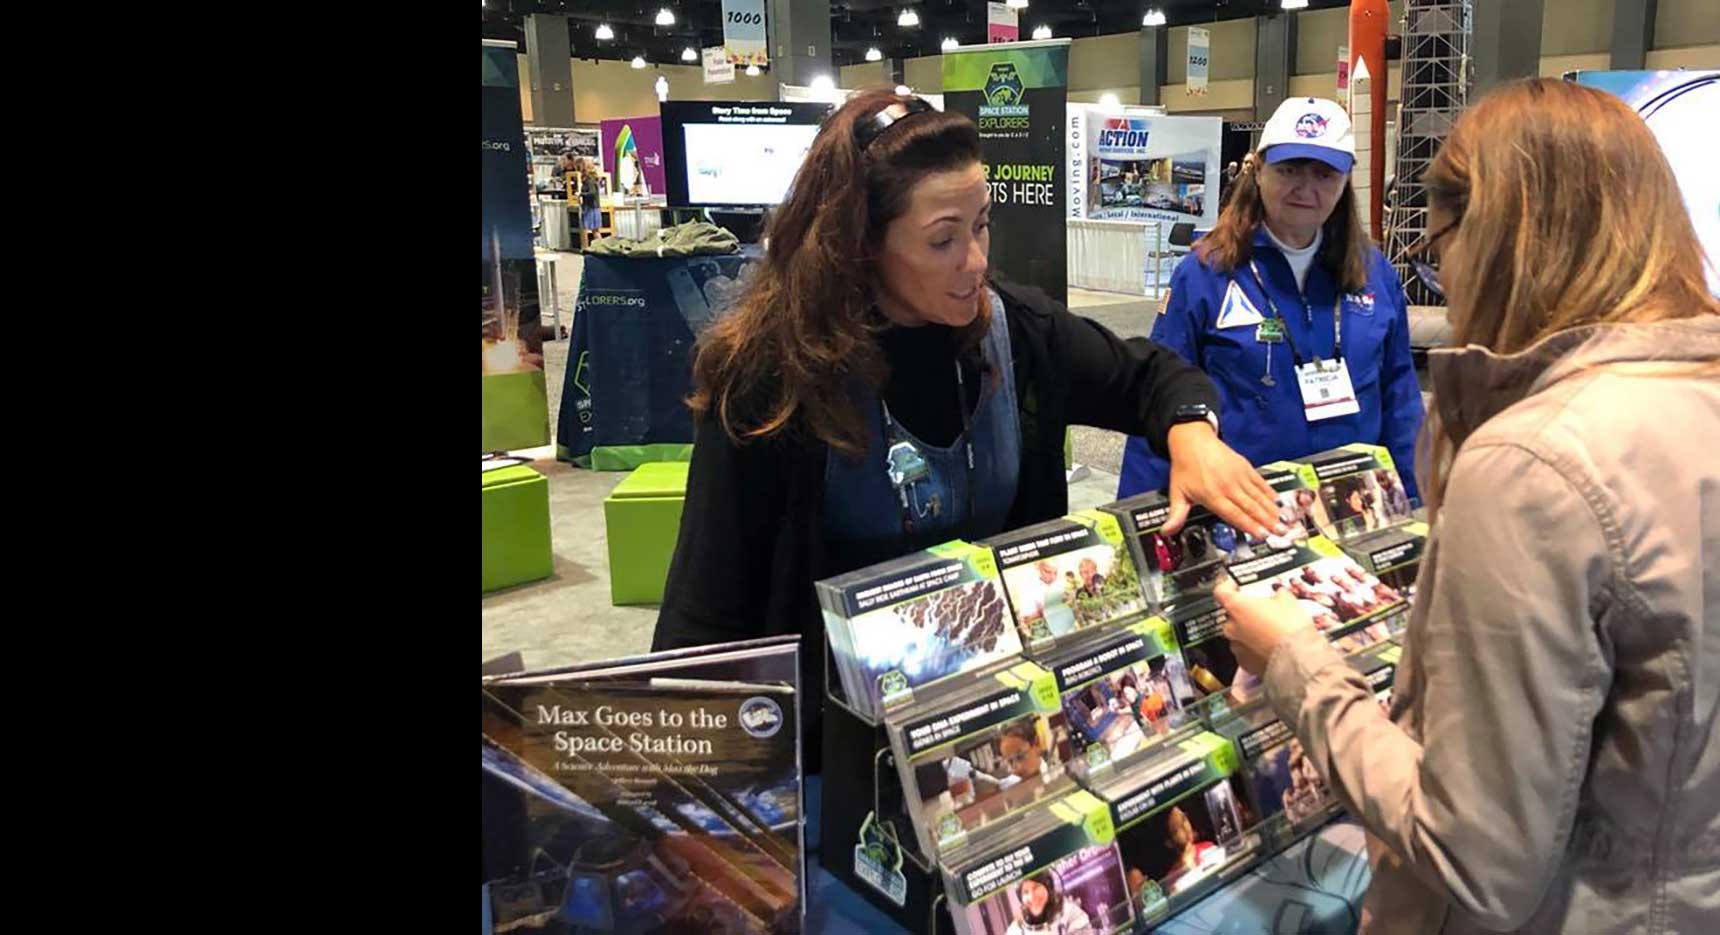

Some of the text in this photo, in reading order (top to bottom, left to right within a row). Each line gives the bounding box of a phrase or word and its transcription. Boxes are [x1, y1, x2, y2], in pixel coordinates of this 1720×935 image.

[728, 11, 761, 24] 1000
[712, 106, 732, 116] Story
[770, 107, 792, 116] Space
[979, 105, 1030, 116] SPACE STATION
[979, 118, 1030, 128] EXPLORERS
[1099, 130, 1149, 147] ACTION
[994, 164, 1054, 181] JOURNEY
[1013, 183, 1054, 205] HERE
[1071, 528, 1089, 539] SPACE
[926, 577, 943, 588] SPACE
[1062, 658, 1094, 677] PROGRAM
[1098, 648, 1118, 663] ROBOT
[1125, 639, 1144, 652] SPACE
[537, 704, 728, 728] Max Goes to the
[910, 725, 931, 738] YOUR
[948, 704, 990, 725] EXPERIMENT
[998, 693, 1020, 708] SPACE
[942, 724, 960, 738] SPACE
[554, 731, 712, 758] Space Station
[700, 764, 718, 776] Dog
[1117, 790, 1150, 812] EXPERIMENT
[1014, 846, 1031, 860] YOUR
[971, 868, 1023, 899] GO FOR LAUNCH
